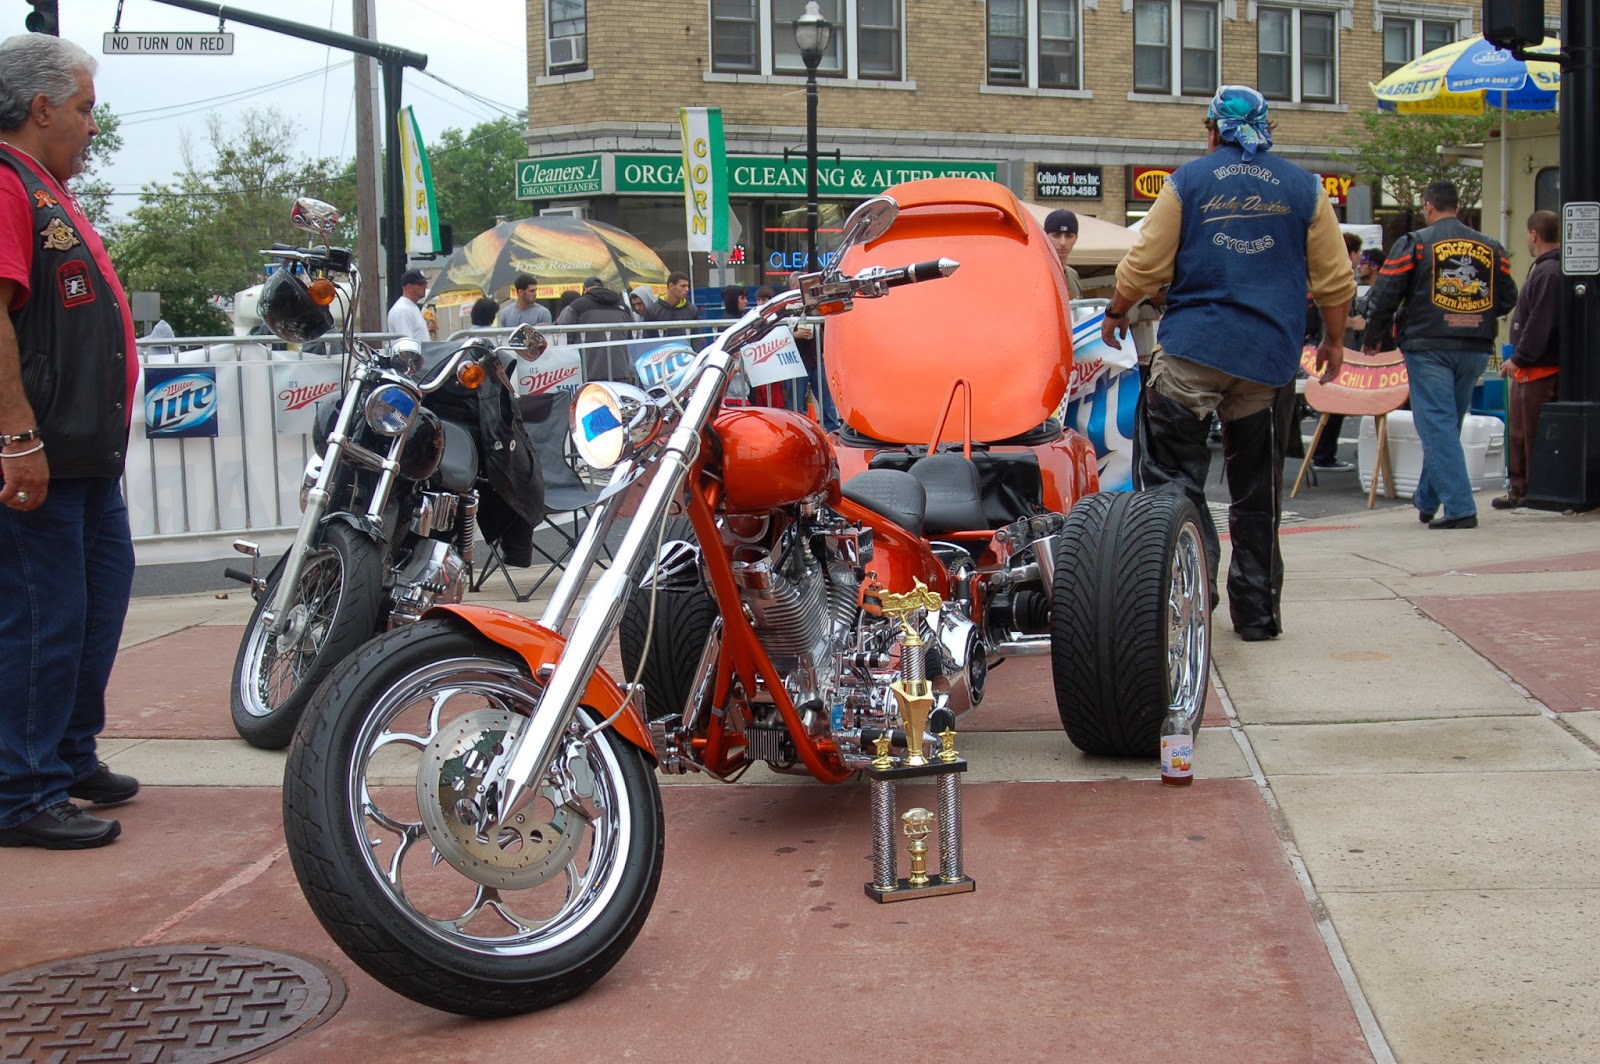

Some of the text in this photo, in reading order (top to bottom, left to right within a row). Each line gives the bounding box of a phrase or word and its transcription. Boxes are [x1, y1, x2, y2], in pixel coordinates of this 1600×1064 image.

[112, 37, 224, 51] NO TURN ON RED
[1376, 77, 1441, 96] SABRETT
[521, 159, 599, 184] Cleaners J
[734, 166, 845, 187] CLEANNG
[850, 168, 867, 187] &
[1037, 171, 1057, 184] Ceibo
[1087, 172, 1100, 185] Inc.
[523, 181, 599, 196] ORGANIC CLEANERS
[692, 137, 708, 236] CORN
[1041, 185, 1097, 196] 1877-539-4585
[1213, 232, 1274, 254] CYCLES
[515, 259, 593, 272] Fresh Roasted
[1434, 293, 1458, 308] PERTH
[744, 336, 791, 366] Miller
[776, 351, 799, 366] TIME
[162, 380, 197, 397] Miller
[519, 366, 580, 396] Miller
[1341, 370, 1374, 389] CHILI
[278, 382, 340, 412] Miller
